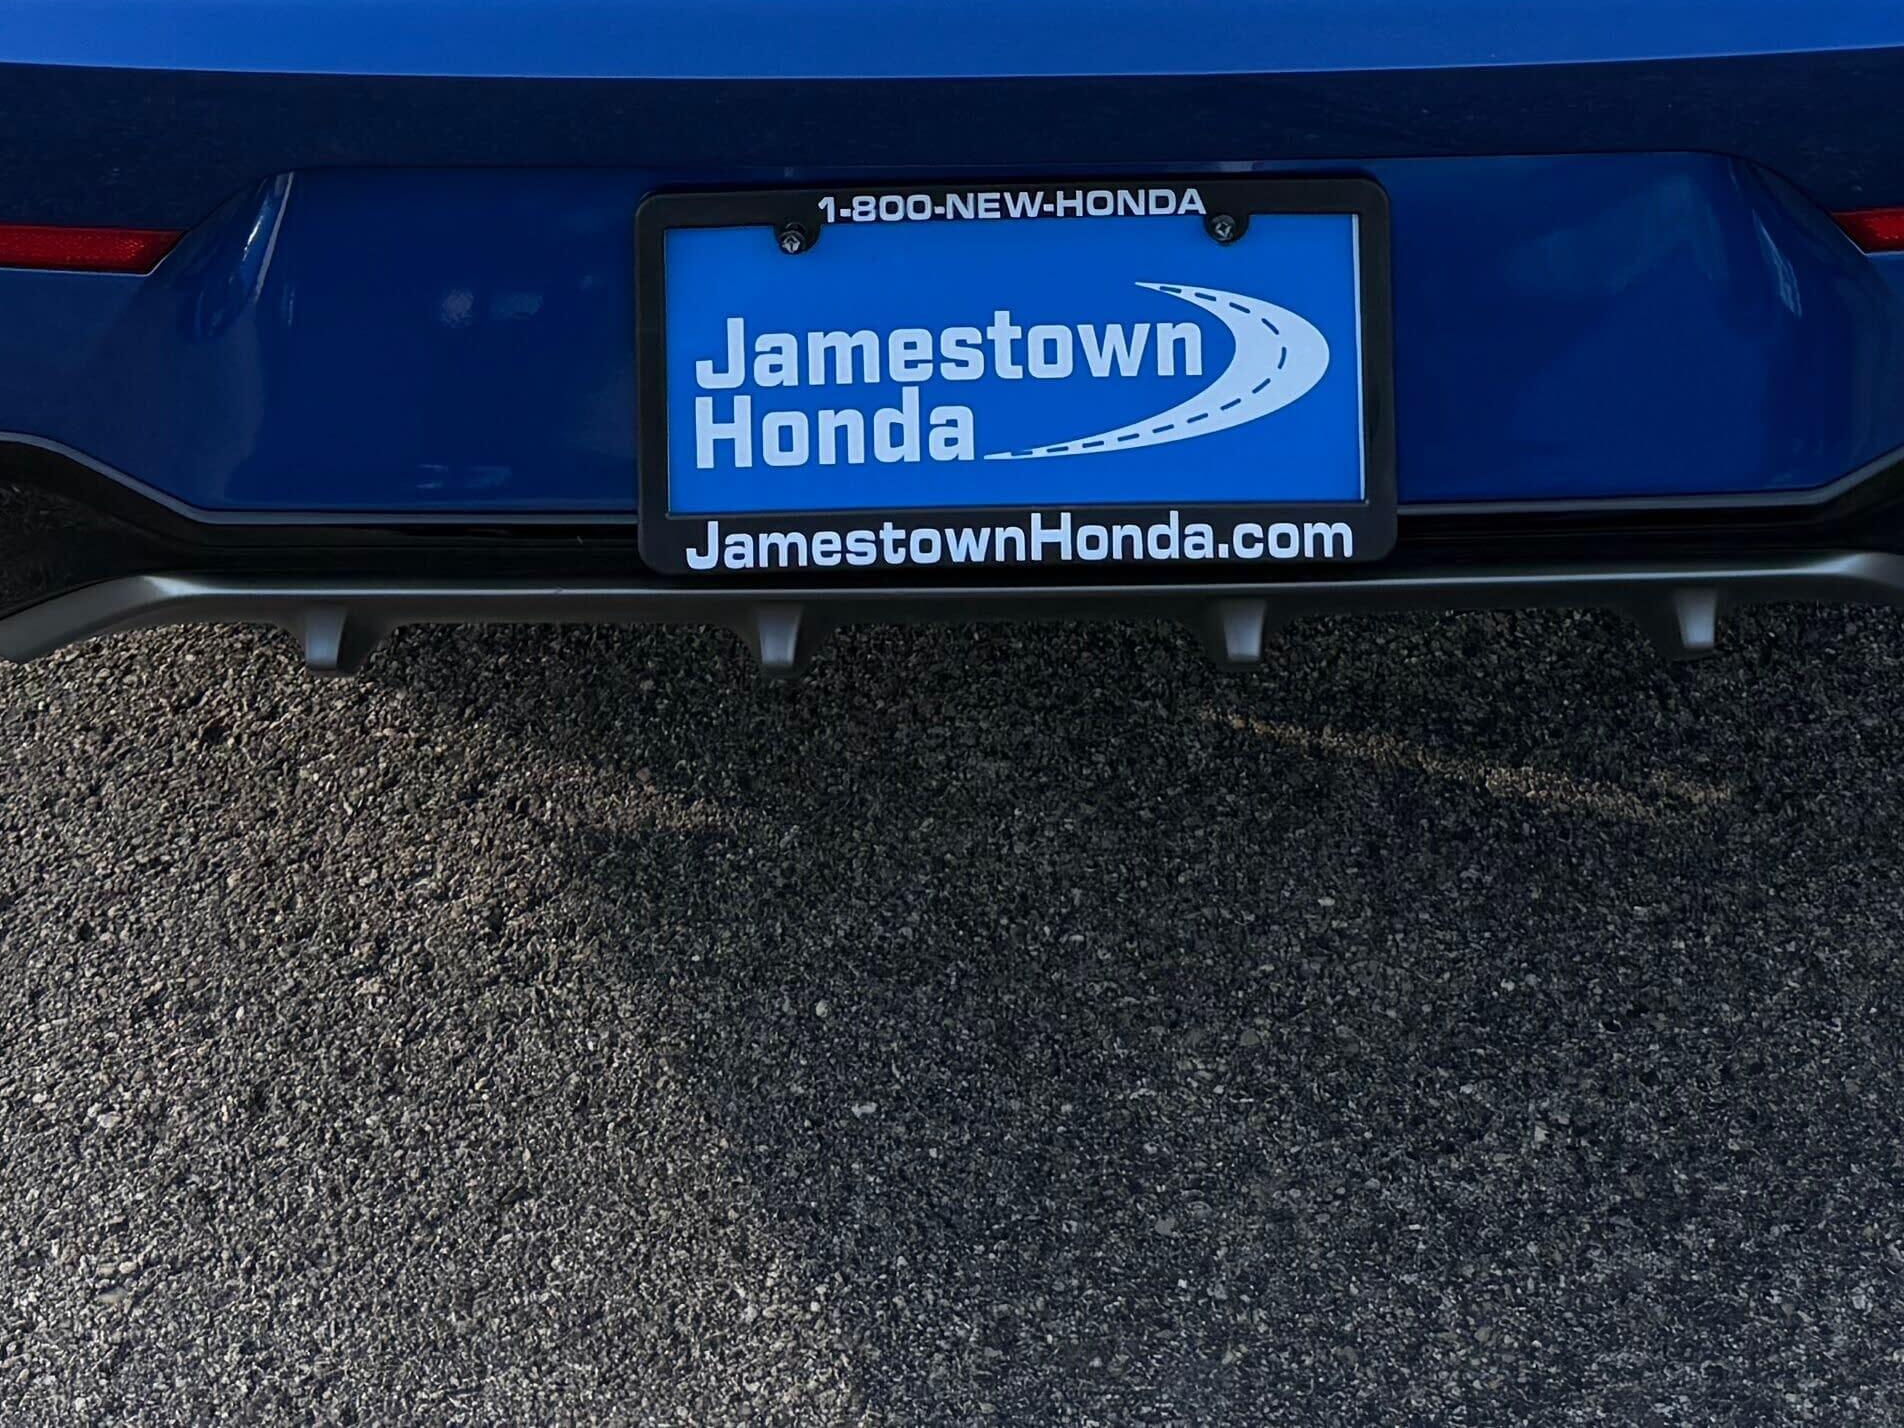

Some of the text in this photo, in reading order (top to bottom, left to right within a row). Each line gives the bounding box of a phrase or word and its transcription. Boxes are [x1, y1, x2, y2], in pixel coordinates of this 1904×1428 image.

[817, 188, 1207, 223] 1-800-NEW-HONDA
[695, 310, 1203, 390] Jamestown
[695, 385, 975, 470] Honda
[684, 510, 1354, 571] JamestownHonda.com
